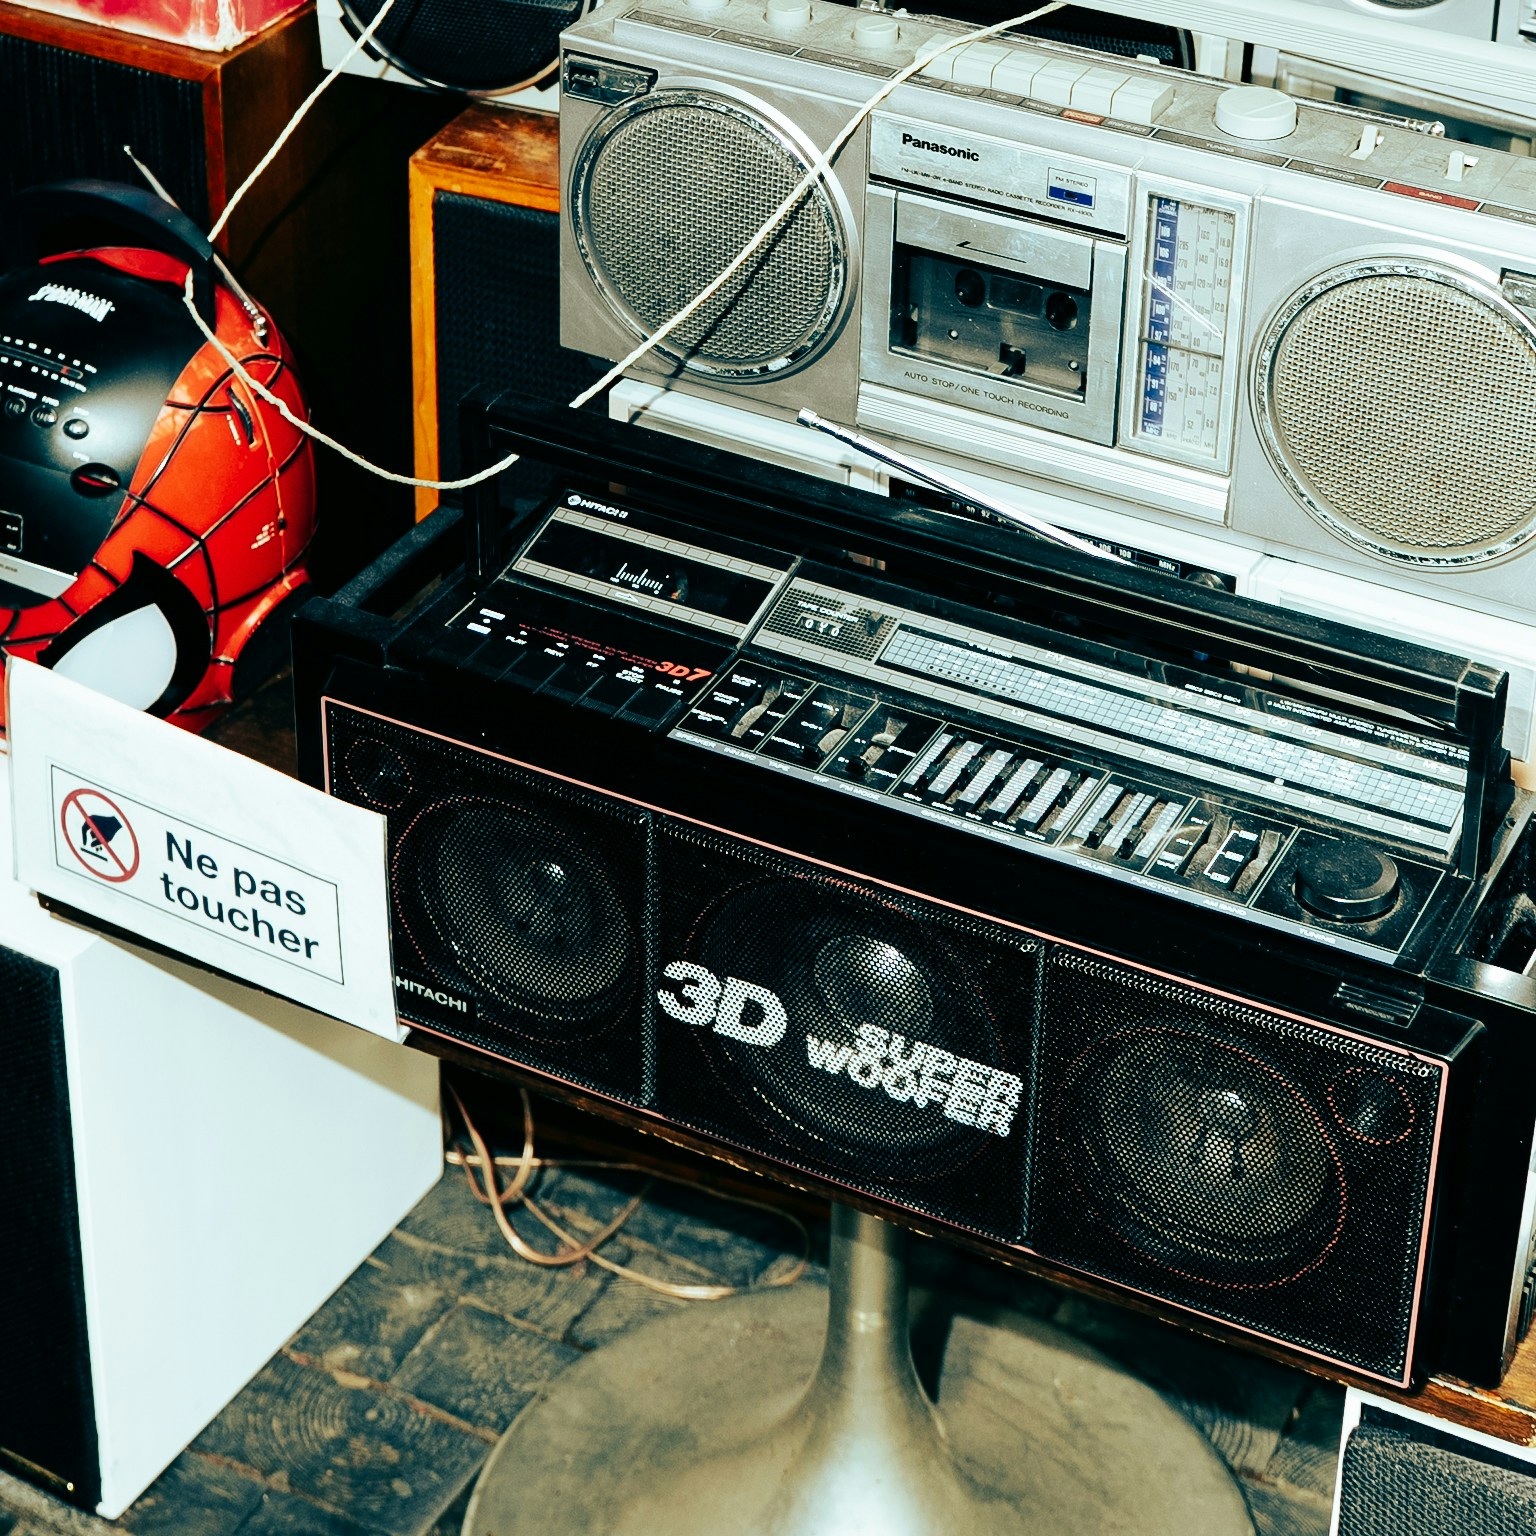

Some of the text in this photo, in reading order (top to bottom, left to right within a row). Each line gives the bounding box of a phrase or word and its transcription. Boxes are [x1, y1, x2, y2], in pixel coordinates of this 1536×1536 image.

[901, 132, 981, 163] Panasonic
[1204, 141, 1235, 153] TUNING
[1054, 175, 1090, 189] FM STEREO
[964, 182, 1067, 212] STEREO RADIO CASSETTE RECORDER
[1417, 190, 1443, 202] BAND
[903, 370, 929, 384] AUTO
[982, 389, 1016, 406] TOUCH
[1016, 398, 1071, 421] RECORDING
[580, 498, 629, 519] HITACHI
[1118, 547, 1177, 573] 108 MHz
[797, 599, 859, 624] TAPE COUNTER
[506, 636, 527, 645] PLAY
[1045, 651, 1065, 662] FM
[655, 661, 713, 683] 3D7
[655, 683, 683, 696] PAUSE
[674, 731, 717, 748] SPEAKER
[1205, 696, 1222, 709] 92
[1267, 715, 1289, 729] 100
[1300, 724, 1323, 738] 104
[1339, 735, 1362, 750] 108
[1422, 760, 1452, 775] MHz
[768, 760, 792, 772] TAPE
[838, 782, 882, 802] FM MODE
[165, 830, 307, 918] Ne pas
[1075, 858, 1115, 876] VOLUME
[1130, 874, 1180, 896] FUNCTION
[159, 872, 320, 960] toucher
[1202, 897, 1248, 917] AM BAND
[1297, 925, 1339, 946] TUNING
[395, 973, 469, 1015] HITACHI
[658, 960, 790, 1048] 3D
[855, 1022, 1024, 1102] SUPER
[806, 1030, 1013, 1139] WOOFER
